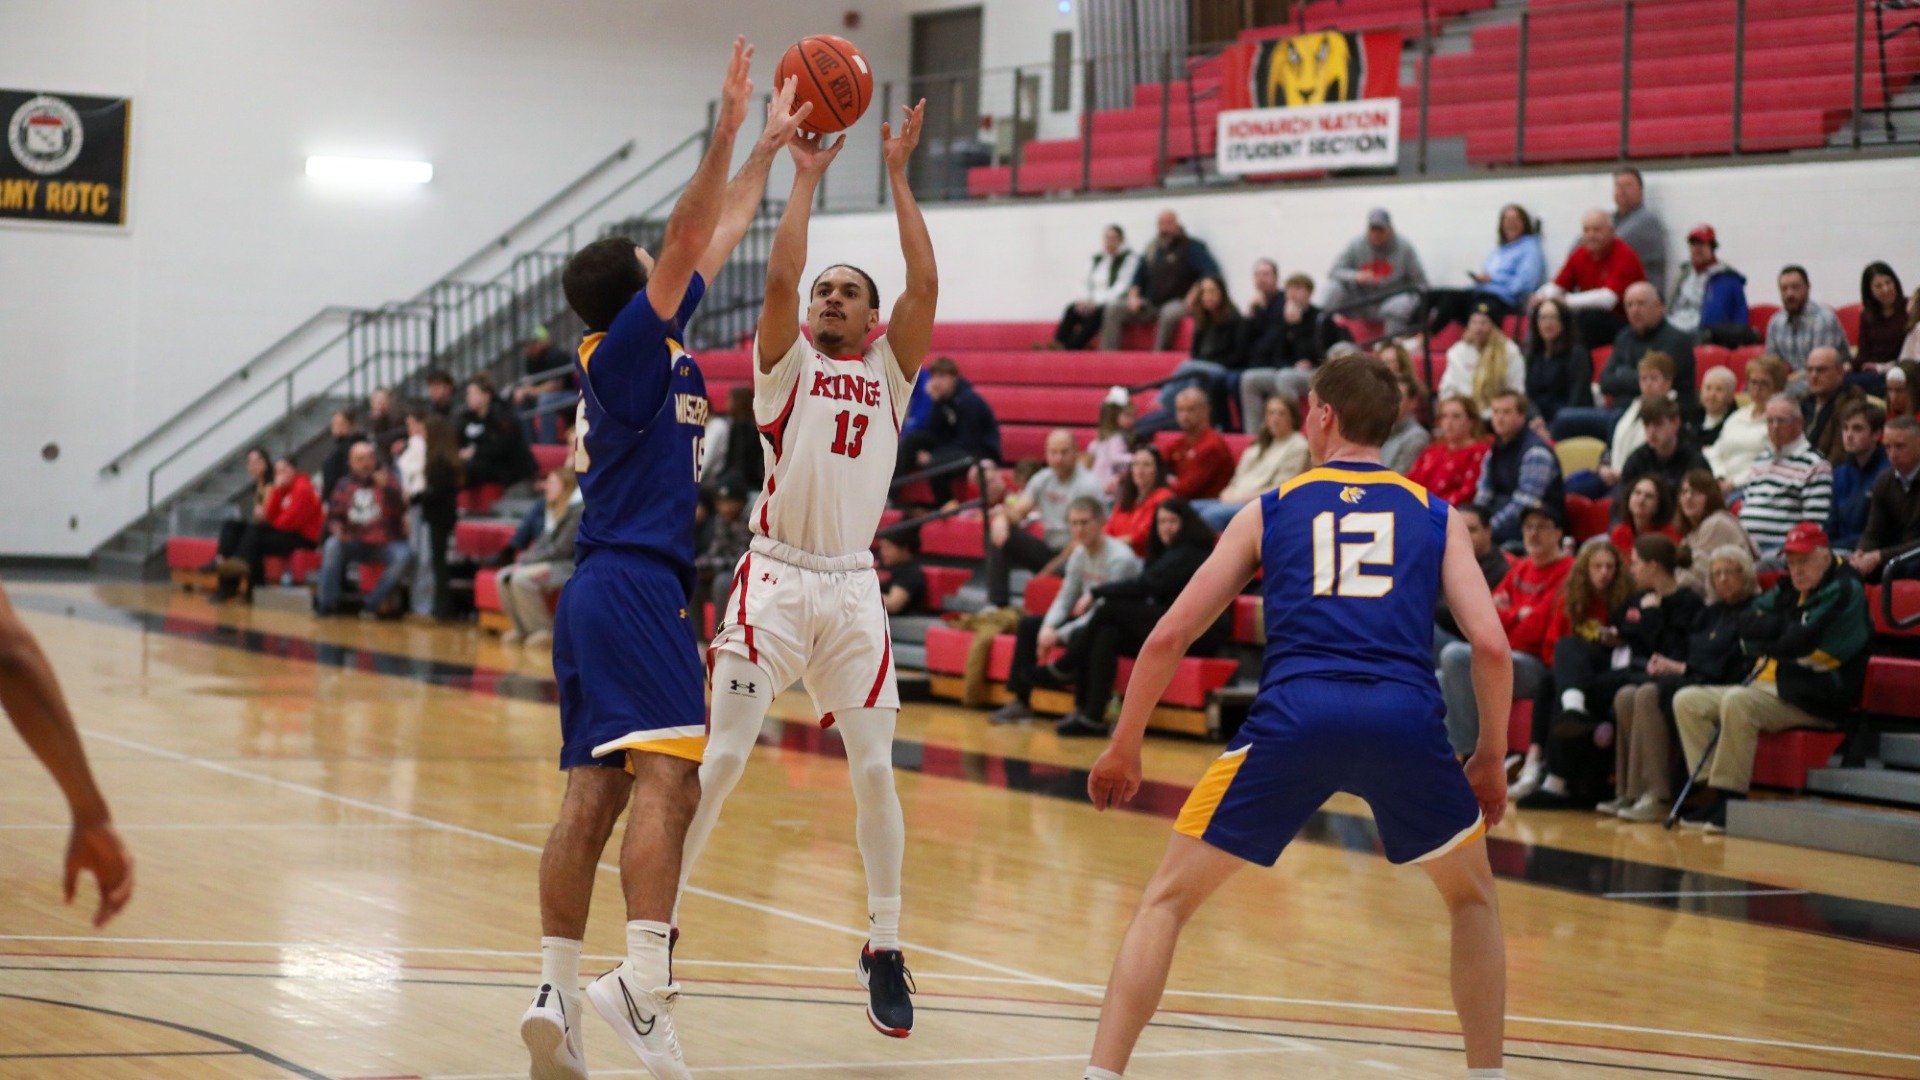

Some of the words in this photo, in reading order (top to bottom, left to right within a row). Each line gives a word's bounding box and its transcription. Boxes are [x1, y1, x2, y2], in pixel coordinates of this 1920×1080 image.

[811, 47, 840, 77] THE
[828, 73, 854, 111] ROCK
[1319, 109, 1388, 131] NATION
[1308, 134, 1387, 155] SECTION
[0, 178, 38, 211] MY
[45, 180, 109, 217] ROTC
[810, 370, 880, 408] KING
[831, 409, 869, 459] 13
[1312, 511, 1395, 597] 12
